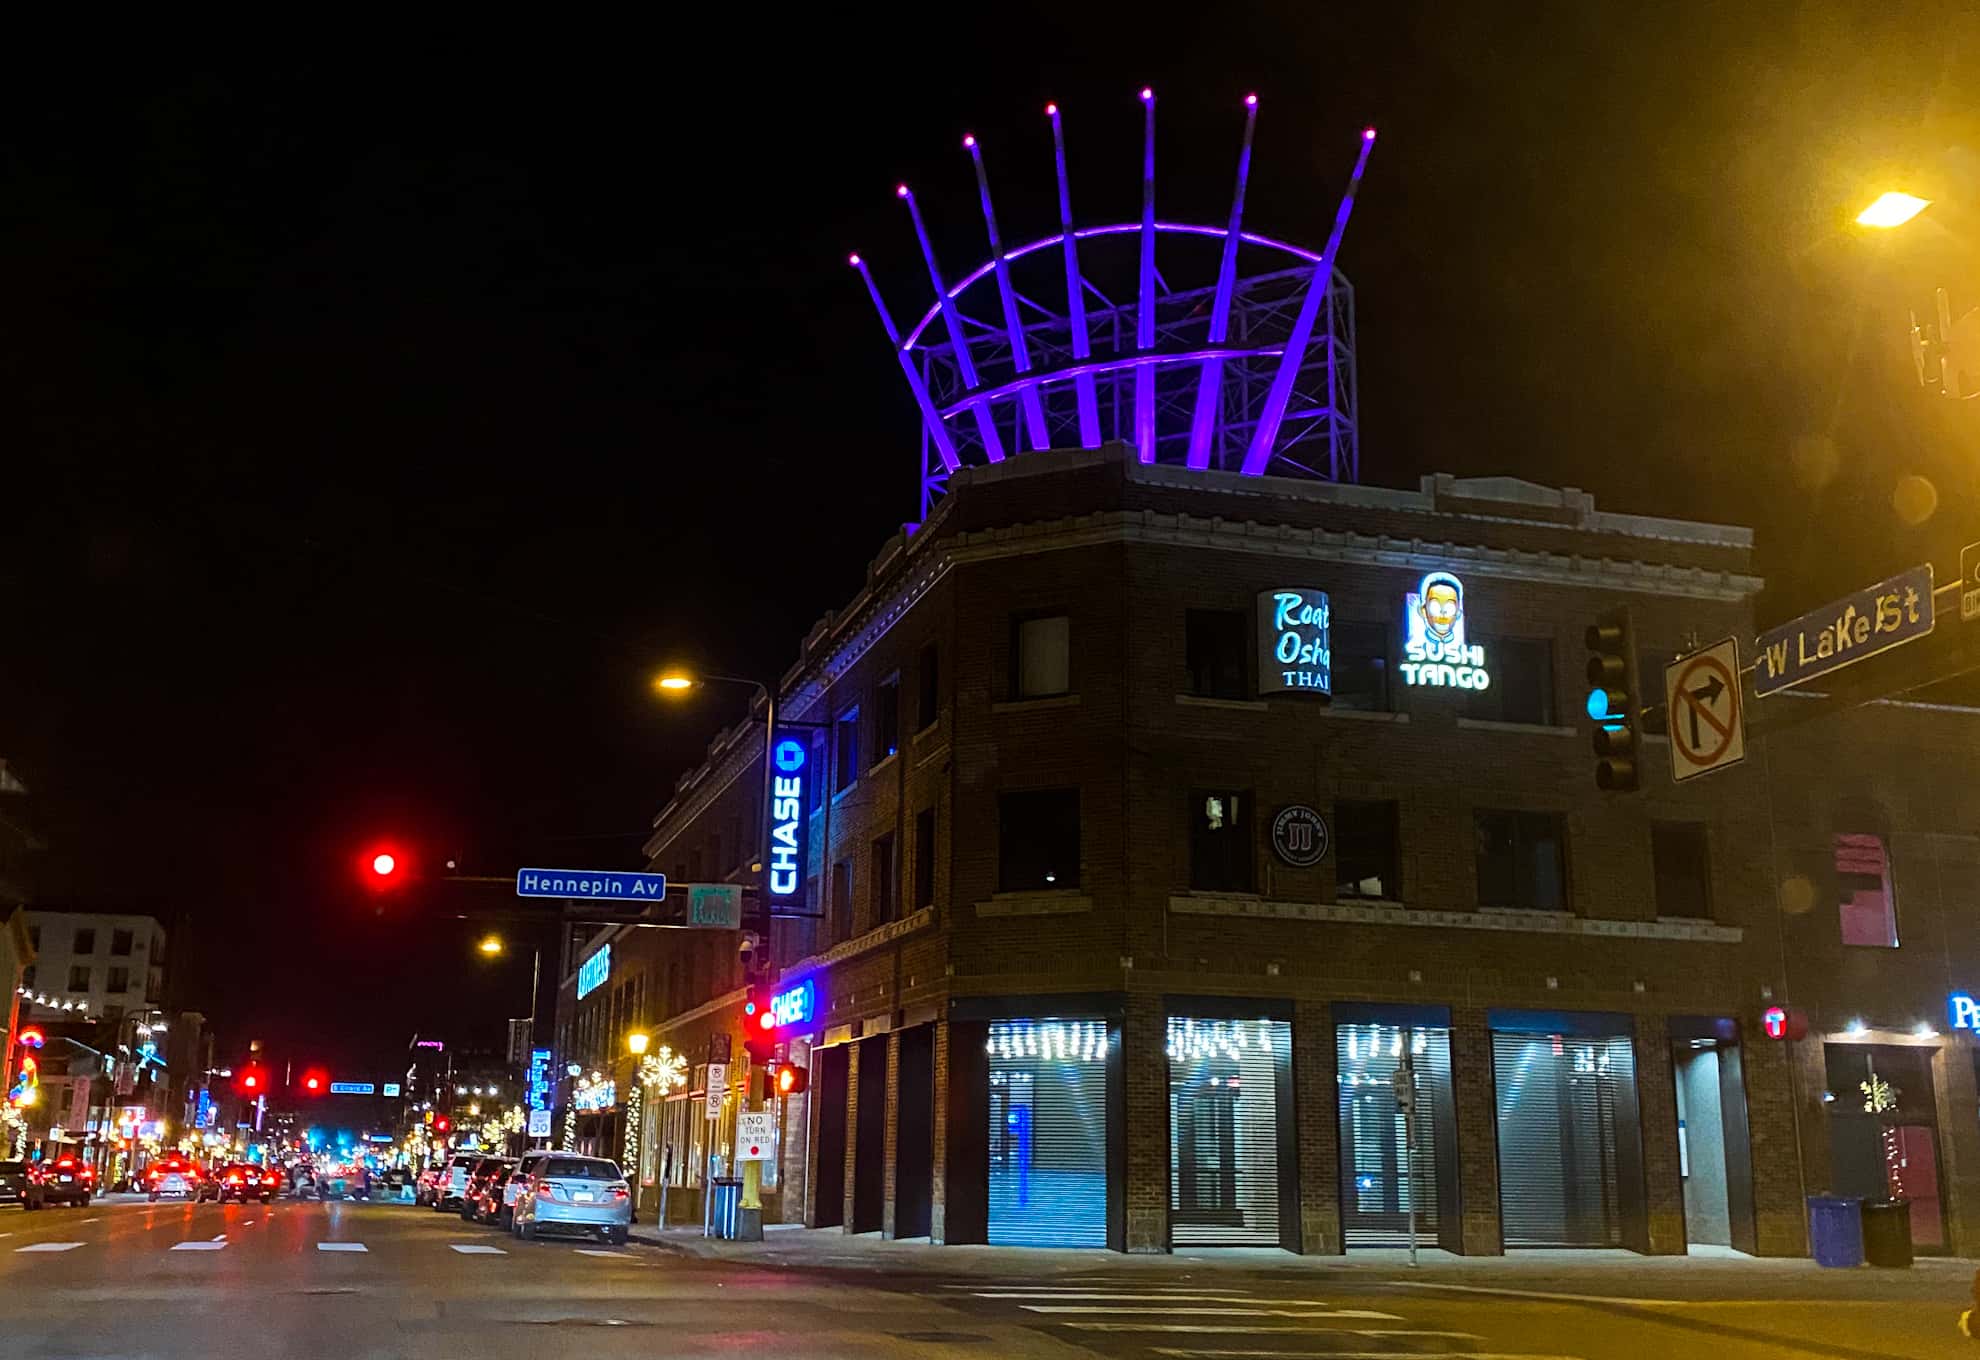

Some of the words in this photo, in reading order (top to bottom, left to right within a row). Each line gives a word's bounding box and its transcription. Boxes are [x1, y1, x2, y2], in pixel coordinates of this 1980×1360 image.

[1273, 592, 1329, 630] Roat
[1277, 631, 1330, 669] Osha
[1766, 639, 1788, 678] W
[1799, 604, 1871, 667] Lake
[1405, 640, 1484, 667] SUSHI
[1282, 671, 1329, 690] THAI
[1400, 663, 1489, 690] TANGO
[770, 775, 800, 894] CHASE
[524, 875, 622, 895] Hennepin
[631, 880, 658, 895] Av
[532, 1123, 548, 1133] 30
[745, 1127, 766, 1135] TURN
[747, 1115, 763, 1125] NO
[740, 1136, 752, 1145] ON
[754, 1136, 770, 1144] RED
